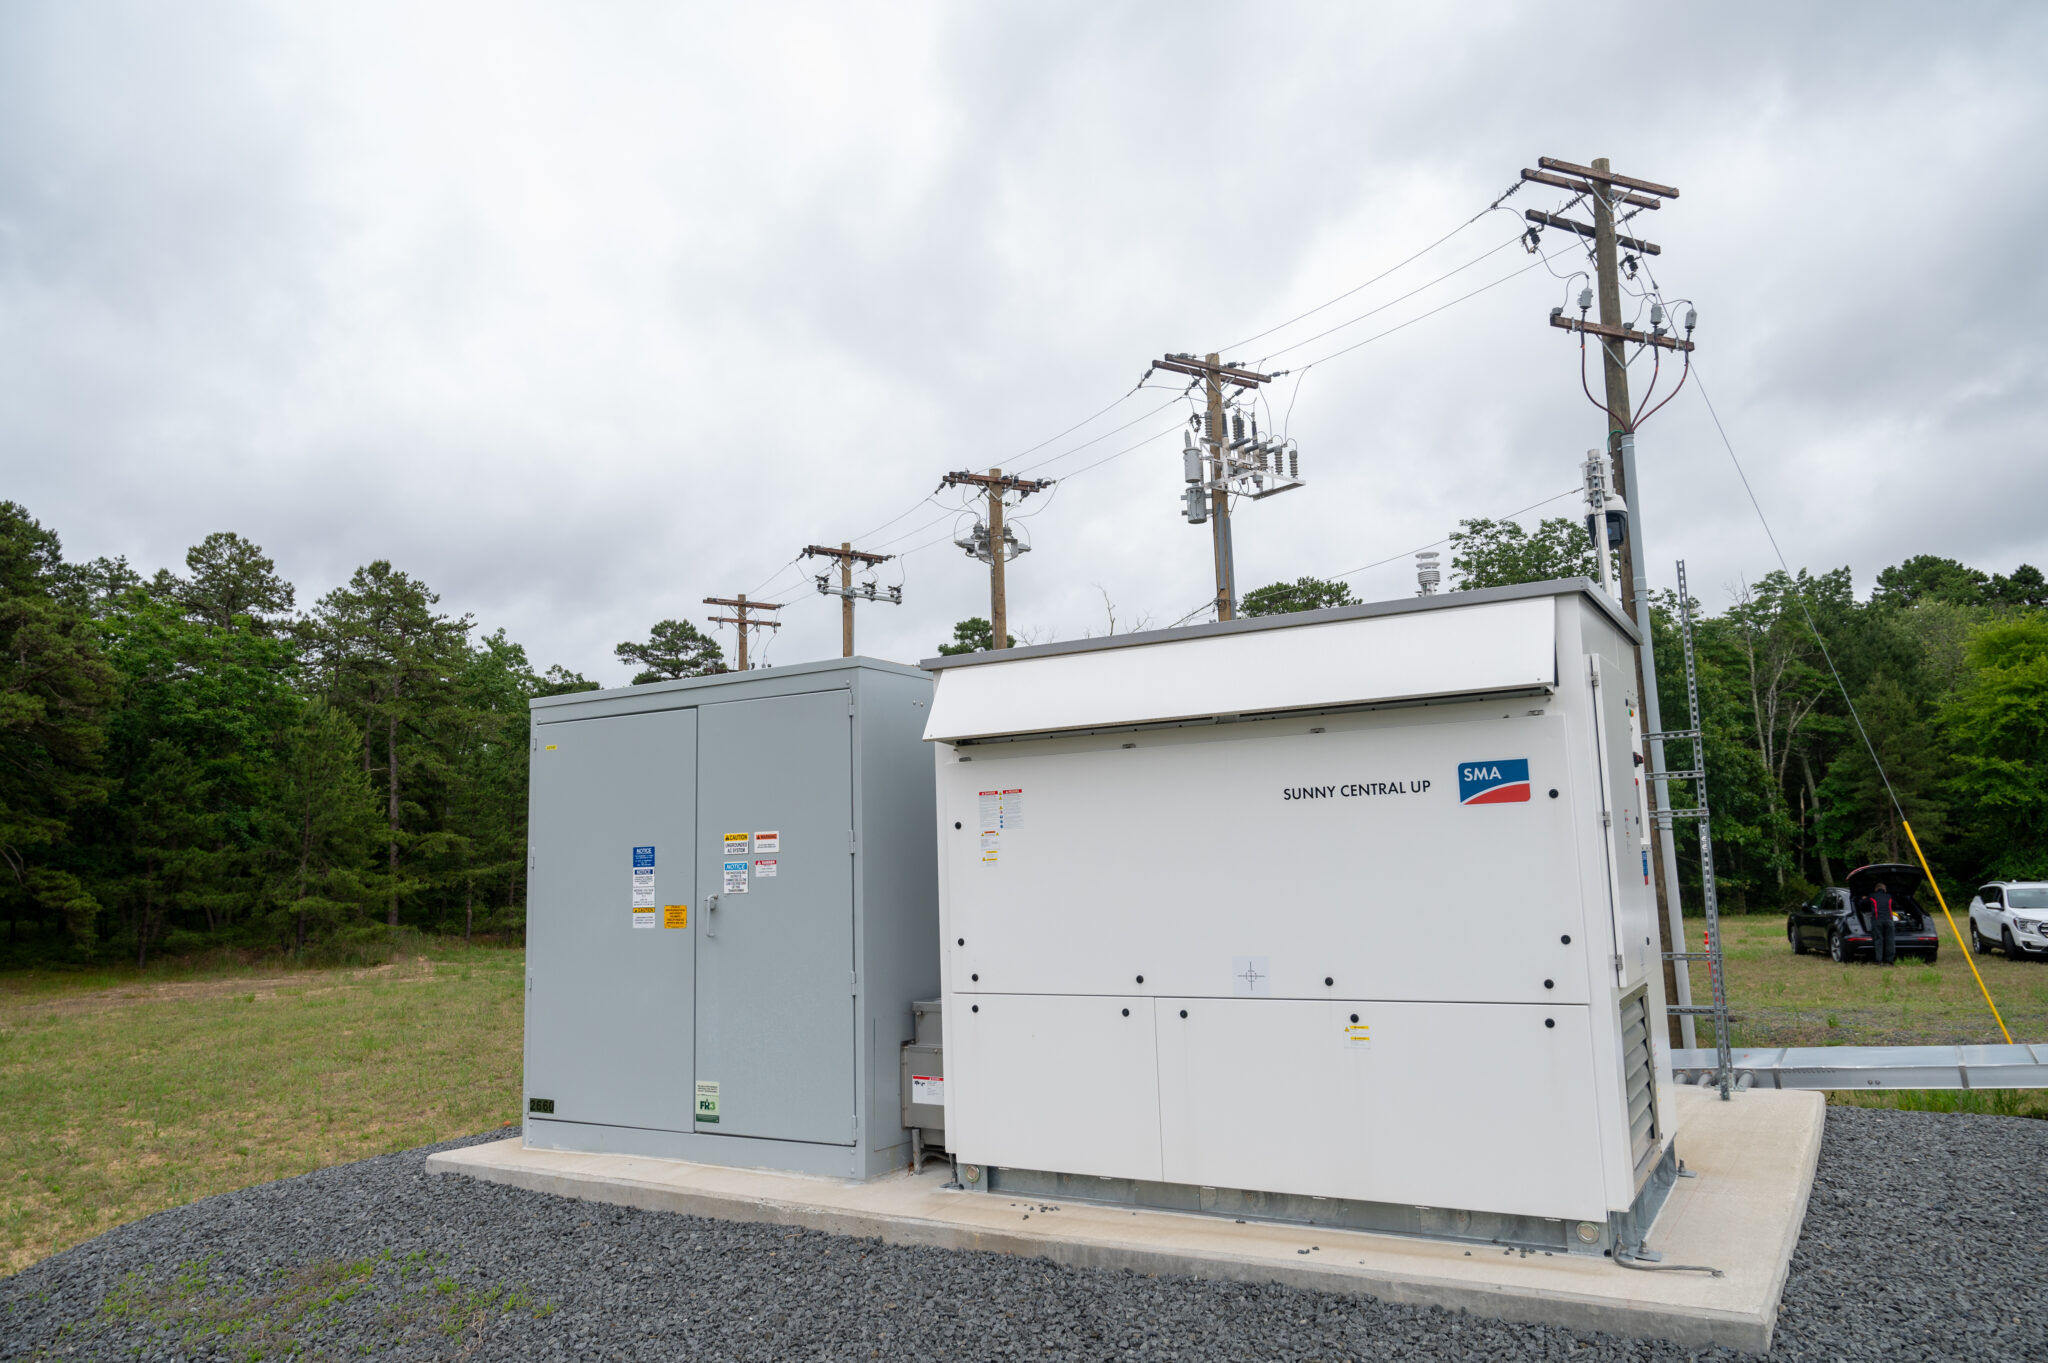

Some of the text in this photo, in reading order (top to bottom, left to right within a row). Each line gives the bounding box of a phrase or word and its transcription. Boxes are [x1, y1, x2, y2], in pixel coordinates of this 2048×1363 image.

[1463, 766, 1502, 782] SMA
[1283, 780, 1431, 801] SUNNY CENTRAL UP
[529, 1099, 554, 1113] 2660
[700, 1100, 716, 1110] FR3
